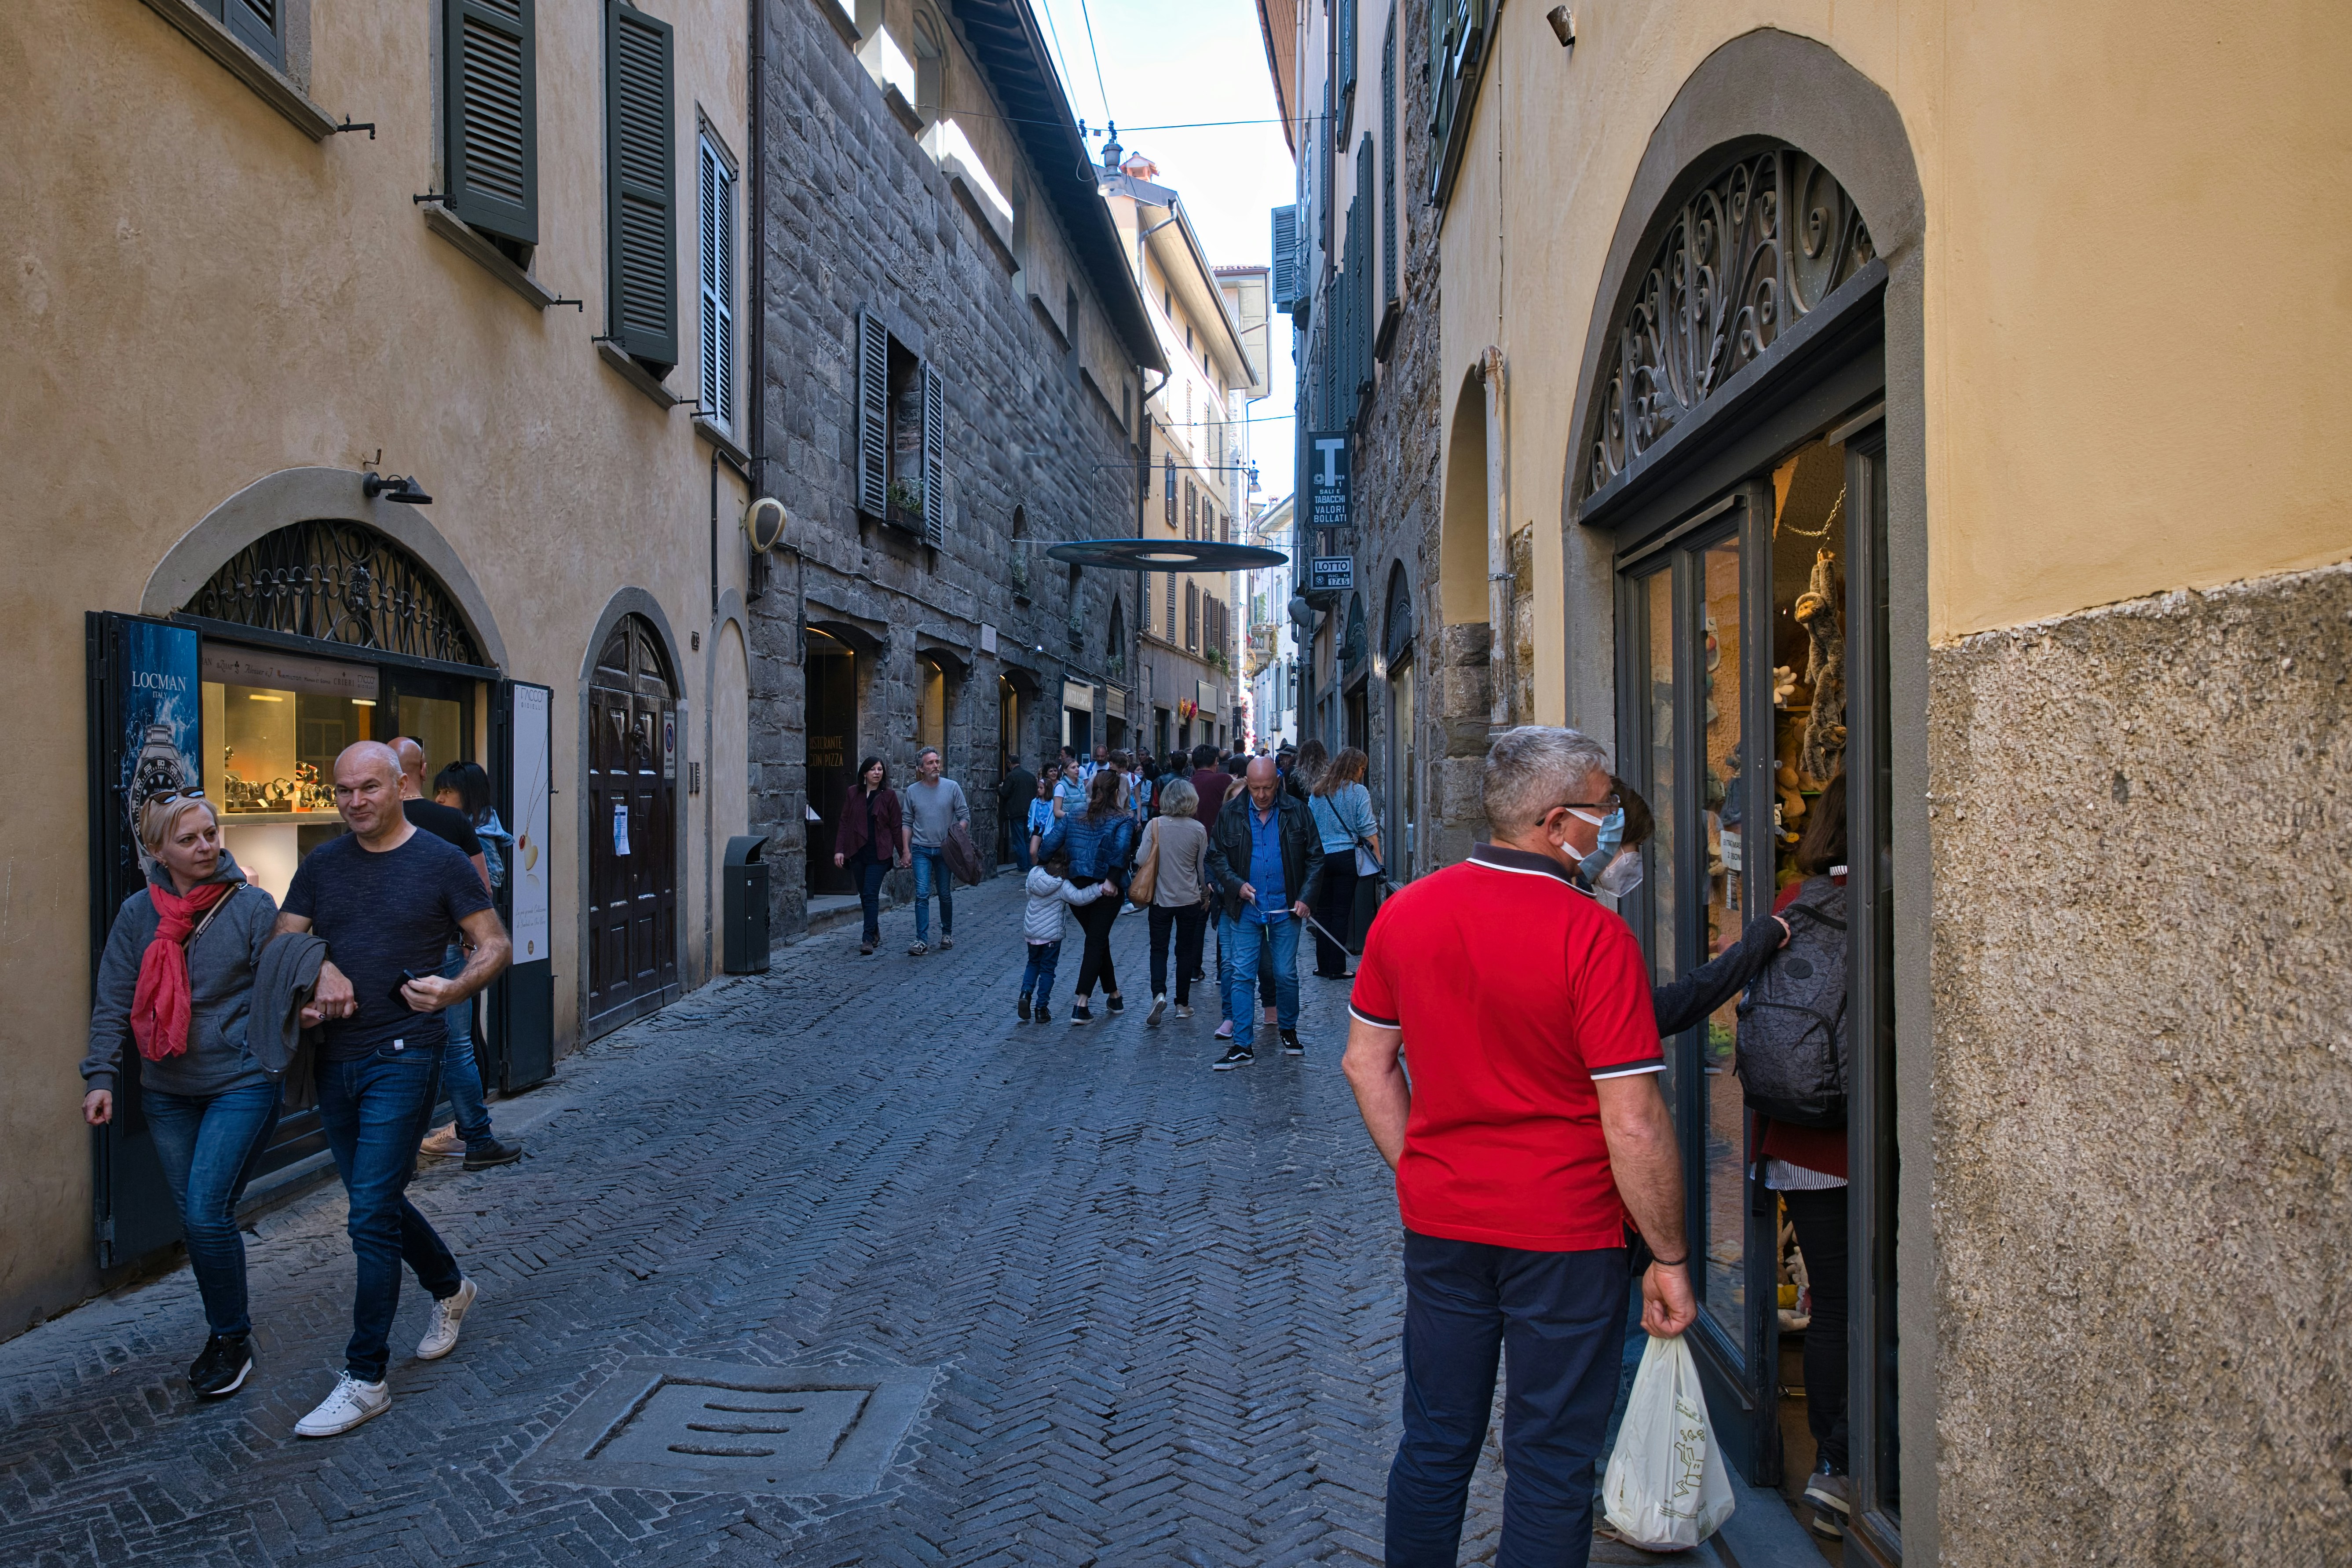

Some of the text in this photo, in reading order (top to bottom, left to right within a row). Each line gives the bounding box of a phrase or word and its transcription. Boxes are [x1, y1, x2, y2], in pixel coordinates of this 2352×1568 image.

[1315, 439, 1344, 486] T
[1315, 495, 1345, 504] TABACCHI
[1315, 505, 1345, 514] VALORI
[1314, 514, 1346, 523] BOLLATI
[1317, 562, 1348, 571] LOTTO
[132, 671, 187, 694] LOCMAN
[333, 678, 354, 687] CRIERI
[521, 702, 542, 710] GIOIELLI
[809, 736, 843, 749] RISTORANTE
[809, 753, 843, 767] CON PIZZA
